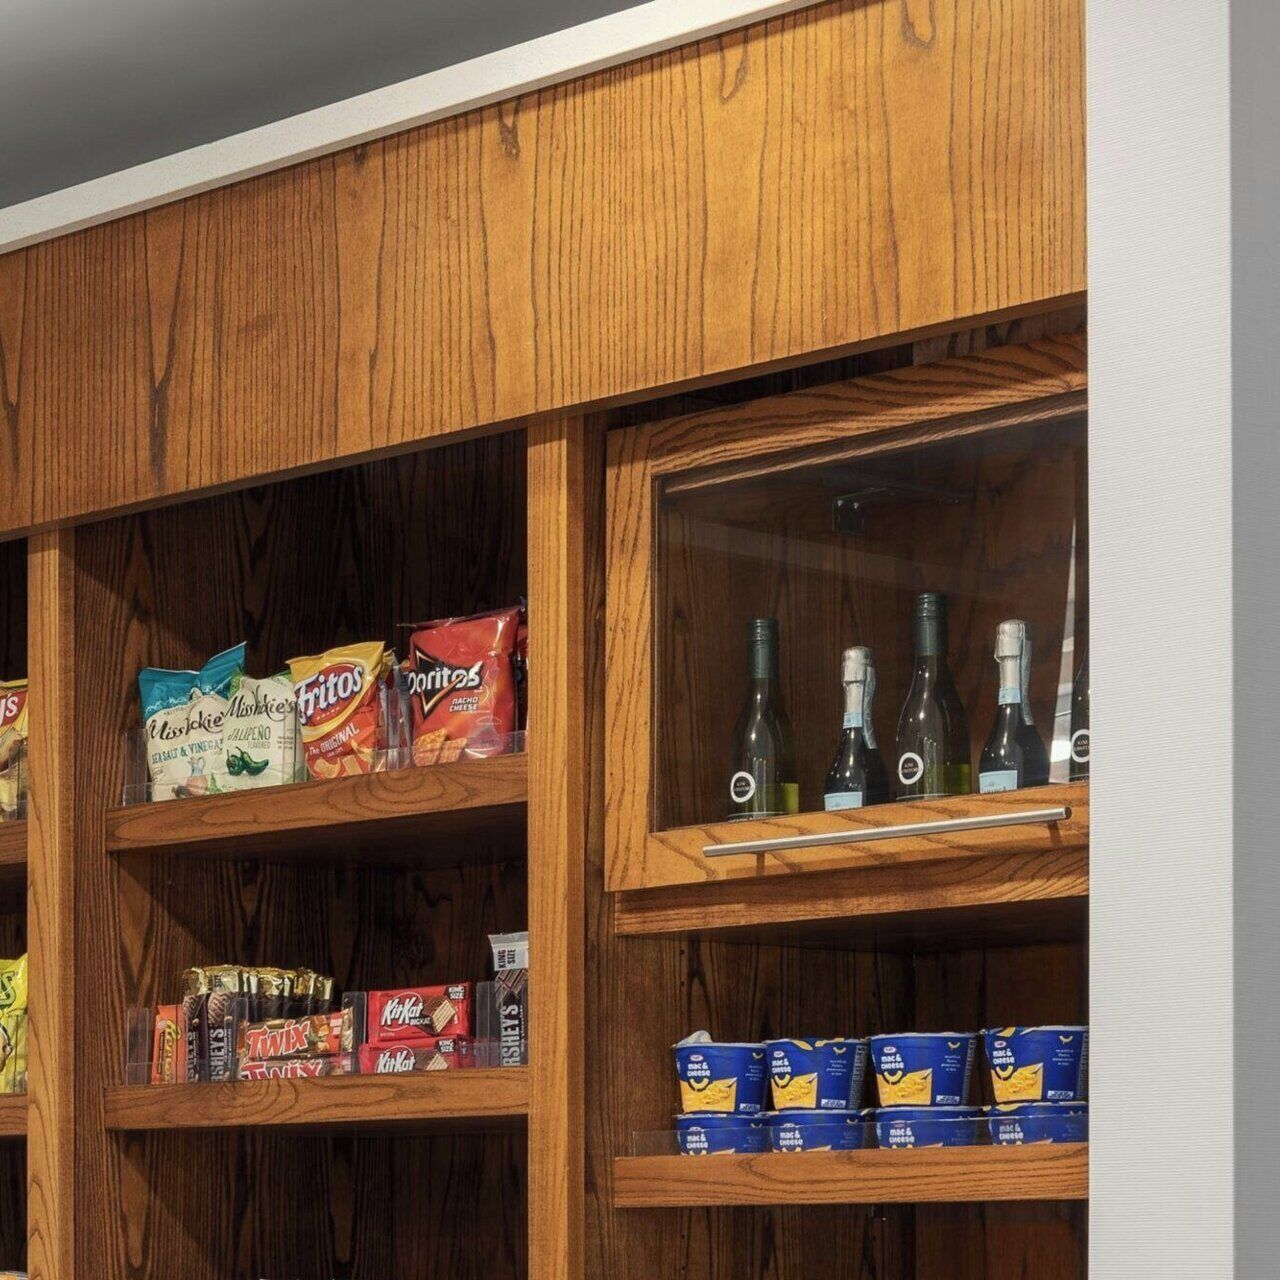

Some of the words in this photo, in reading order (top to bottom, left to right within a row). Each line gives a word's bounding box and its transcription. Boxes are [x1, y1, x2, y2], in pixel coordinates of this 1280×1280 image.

[294, 666, 363, 725] Fritos
[449, 704, 479, 712] CHEESE
[320, 723, 360, 752] ORIGINAL
[180, 746, 189, 757] &
[498, 949, 506, 969] KING
[507, 948, 516, 964] SIZE
[246, 1020, 311, 1060] Twix
[502, 1004, 520, 1066] RSHEY'S
[896, 1054, 902, 1062] &
[1006, 1048, 1013, 1056] &
[783, 1058, 789, 1066] &
